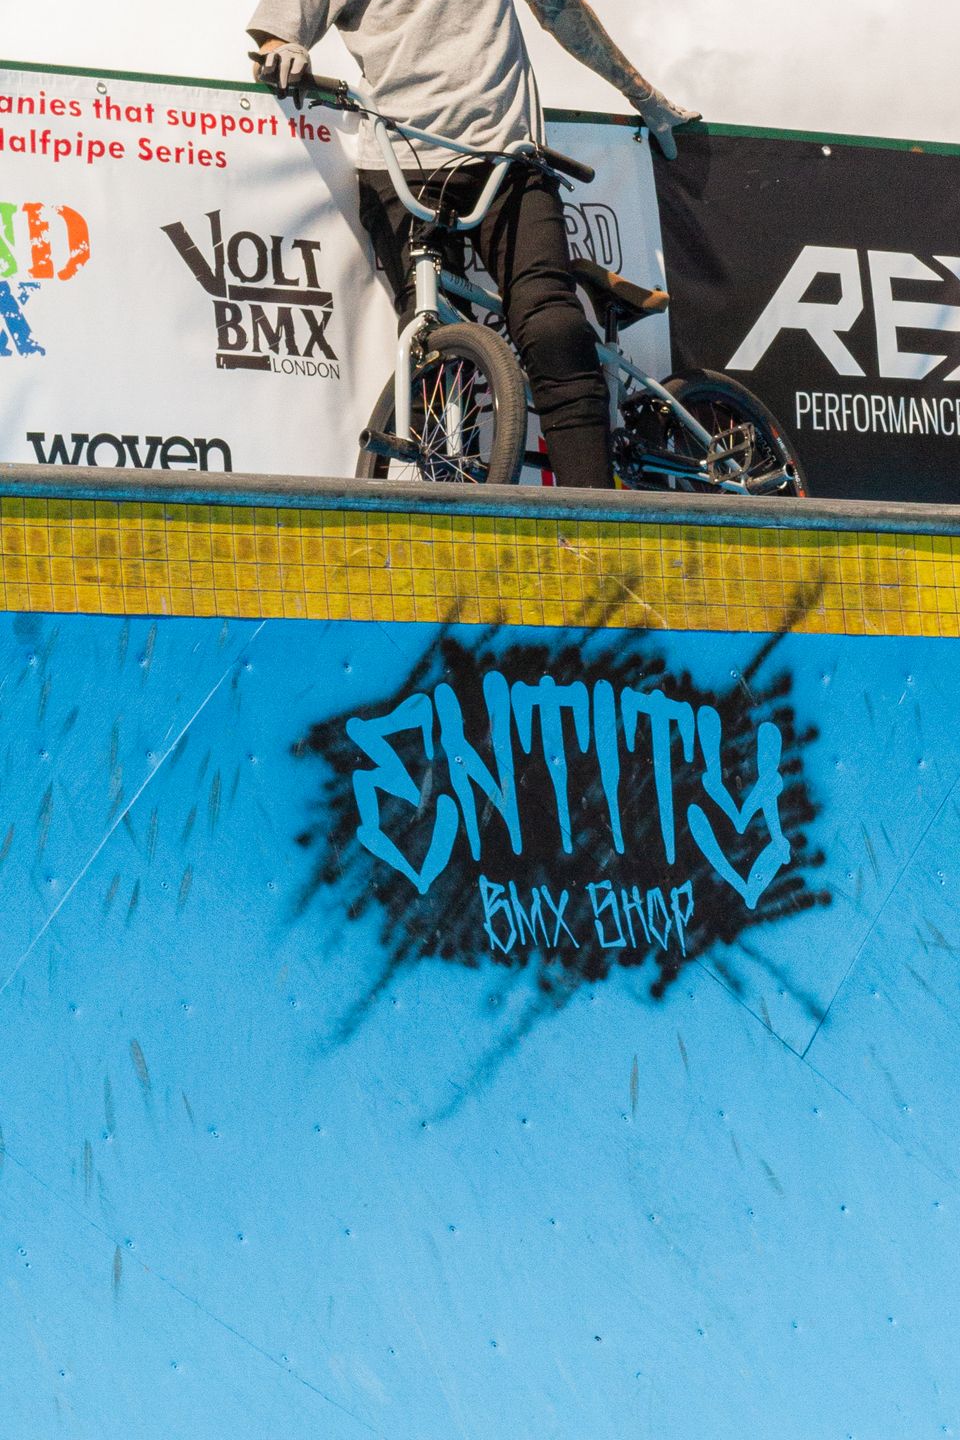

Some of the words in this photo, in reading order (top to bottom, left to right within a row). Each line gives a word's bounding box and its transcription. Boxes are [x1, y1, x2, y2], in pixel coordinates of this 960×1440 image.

[0, 91, 82, 117] anies
[92, 96, 155, 124] that
[166, 109, 279, 137] support
[288, 115, 332, 143] the
[0, 127, 125, 165] alfpipe
[138, 137, 227, 168] Series
[160, 209, 321, 298] VOLT
[212, 299, 340, 361] BMX
[273, 358, 341, 380] LONDON
[26, 431, 233, 472] woven
[346, 670, 790, 909] ENTITY
[479, 874, 579, 955] BMX
[585, 879, 693, 957] SHOP
